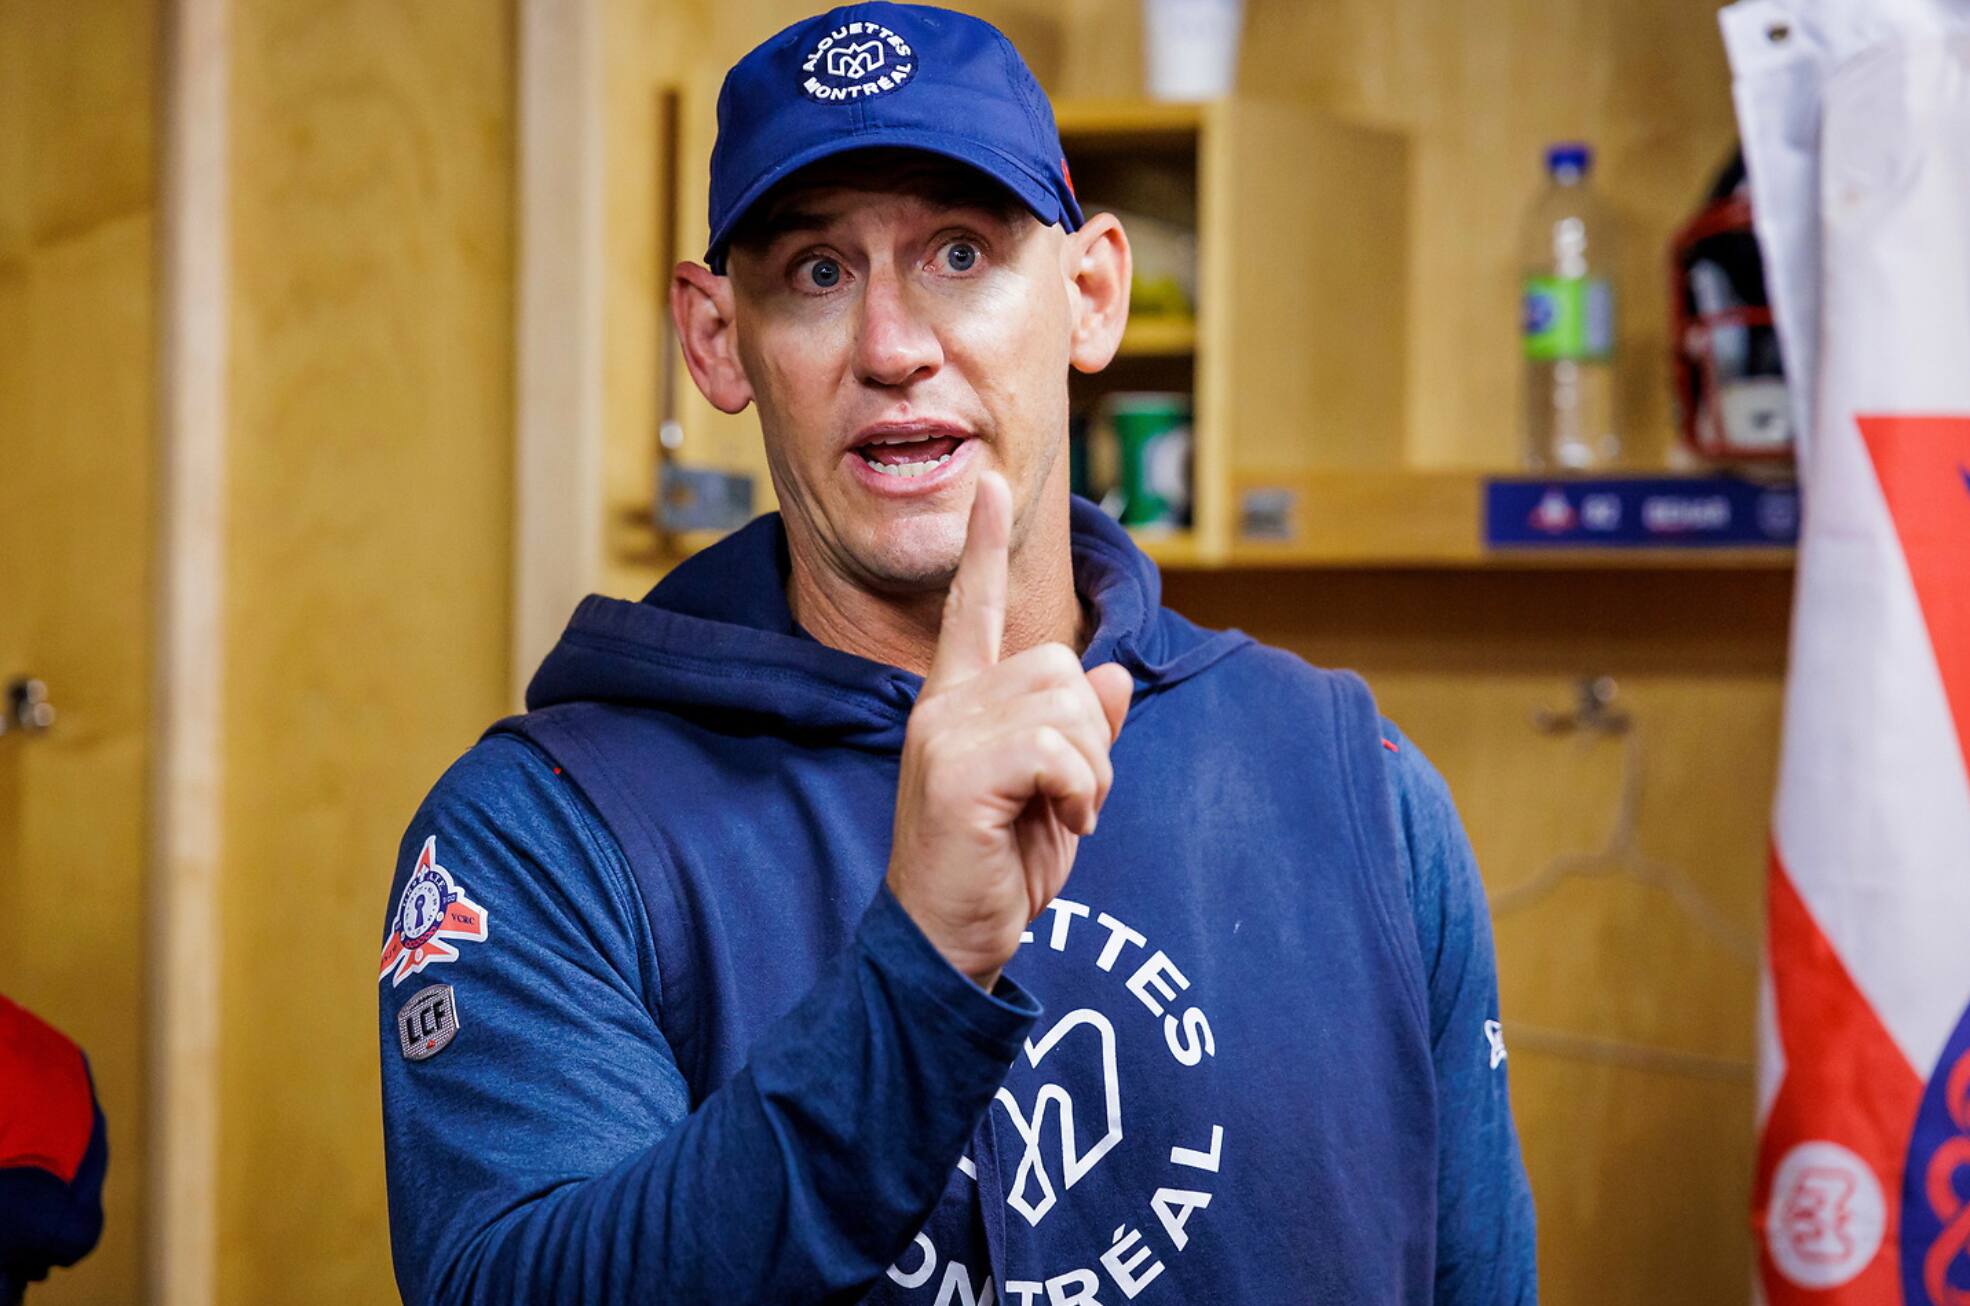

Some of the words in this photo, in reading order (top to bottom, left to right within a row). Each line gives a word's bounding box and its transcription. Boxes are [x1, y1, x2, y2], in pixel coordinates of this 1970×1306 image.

[802, 21, 911, 72] ALOUETTES
[803, 63, 912, 100] MONTRÉAL
[406, 999, 446, 1045] LCF
[886, 1124, 1224, 1306] ONTRÉAL
